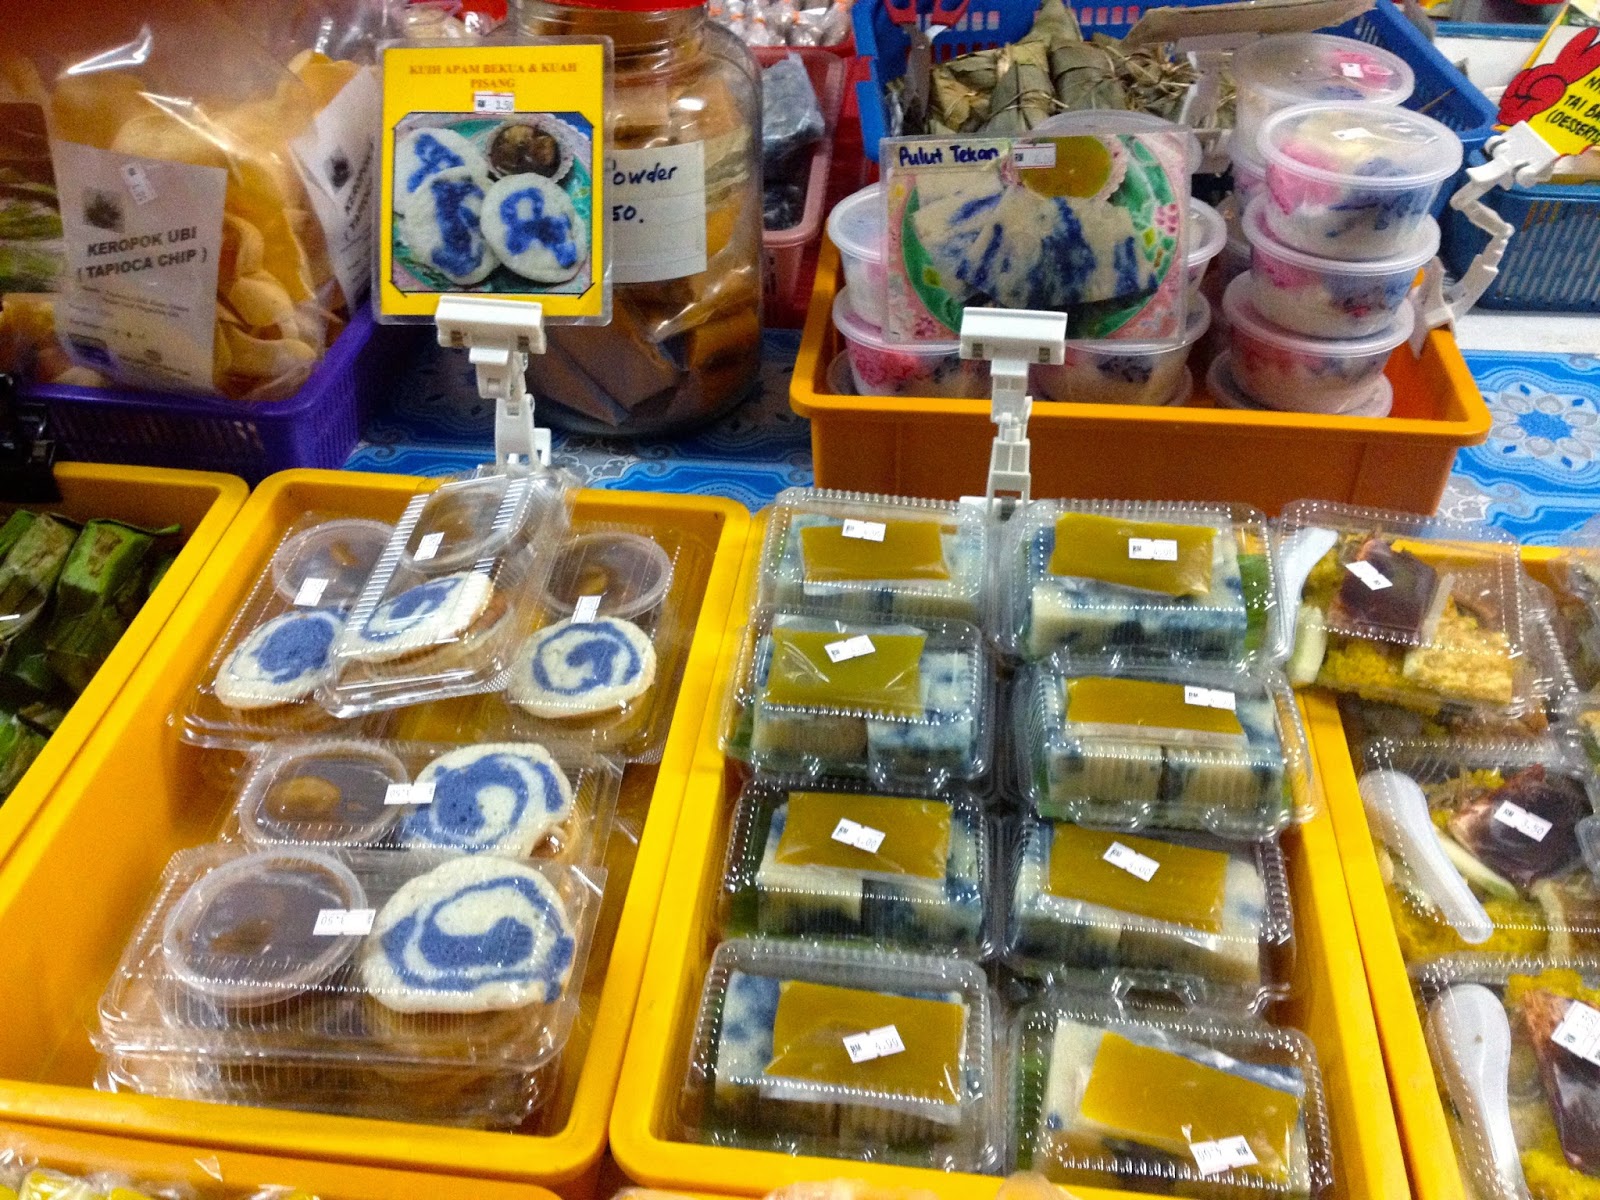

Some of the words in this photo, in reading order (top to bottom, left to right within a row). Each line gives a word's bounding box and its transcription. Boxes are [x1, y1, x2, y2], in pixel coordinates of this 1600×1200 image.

[446, 64, 480, 75] APAM
[483, 63, 525, 74] BEKUA
[528, 63, 537, 73] &
[541, 62, 578, 73] KUAH
[470, 79, 515, 88] PISANG
[1564, 94, 1588, 111] TAI
[899, 146, 943, 167] Pulut
[949, 144, 998, 163] Tekan
[87, 232, 163, 257] KEROPOK
[167, 226, 198, 243] UBI
[86, 257, 153, 279] TAPIOCA
[157, 248, 198, 267] CHIP
